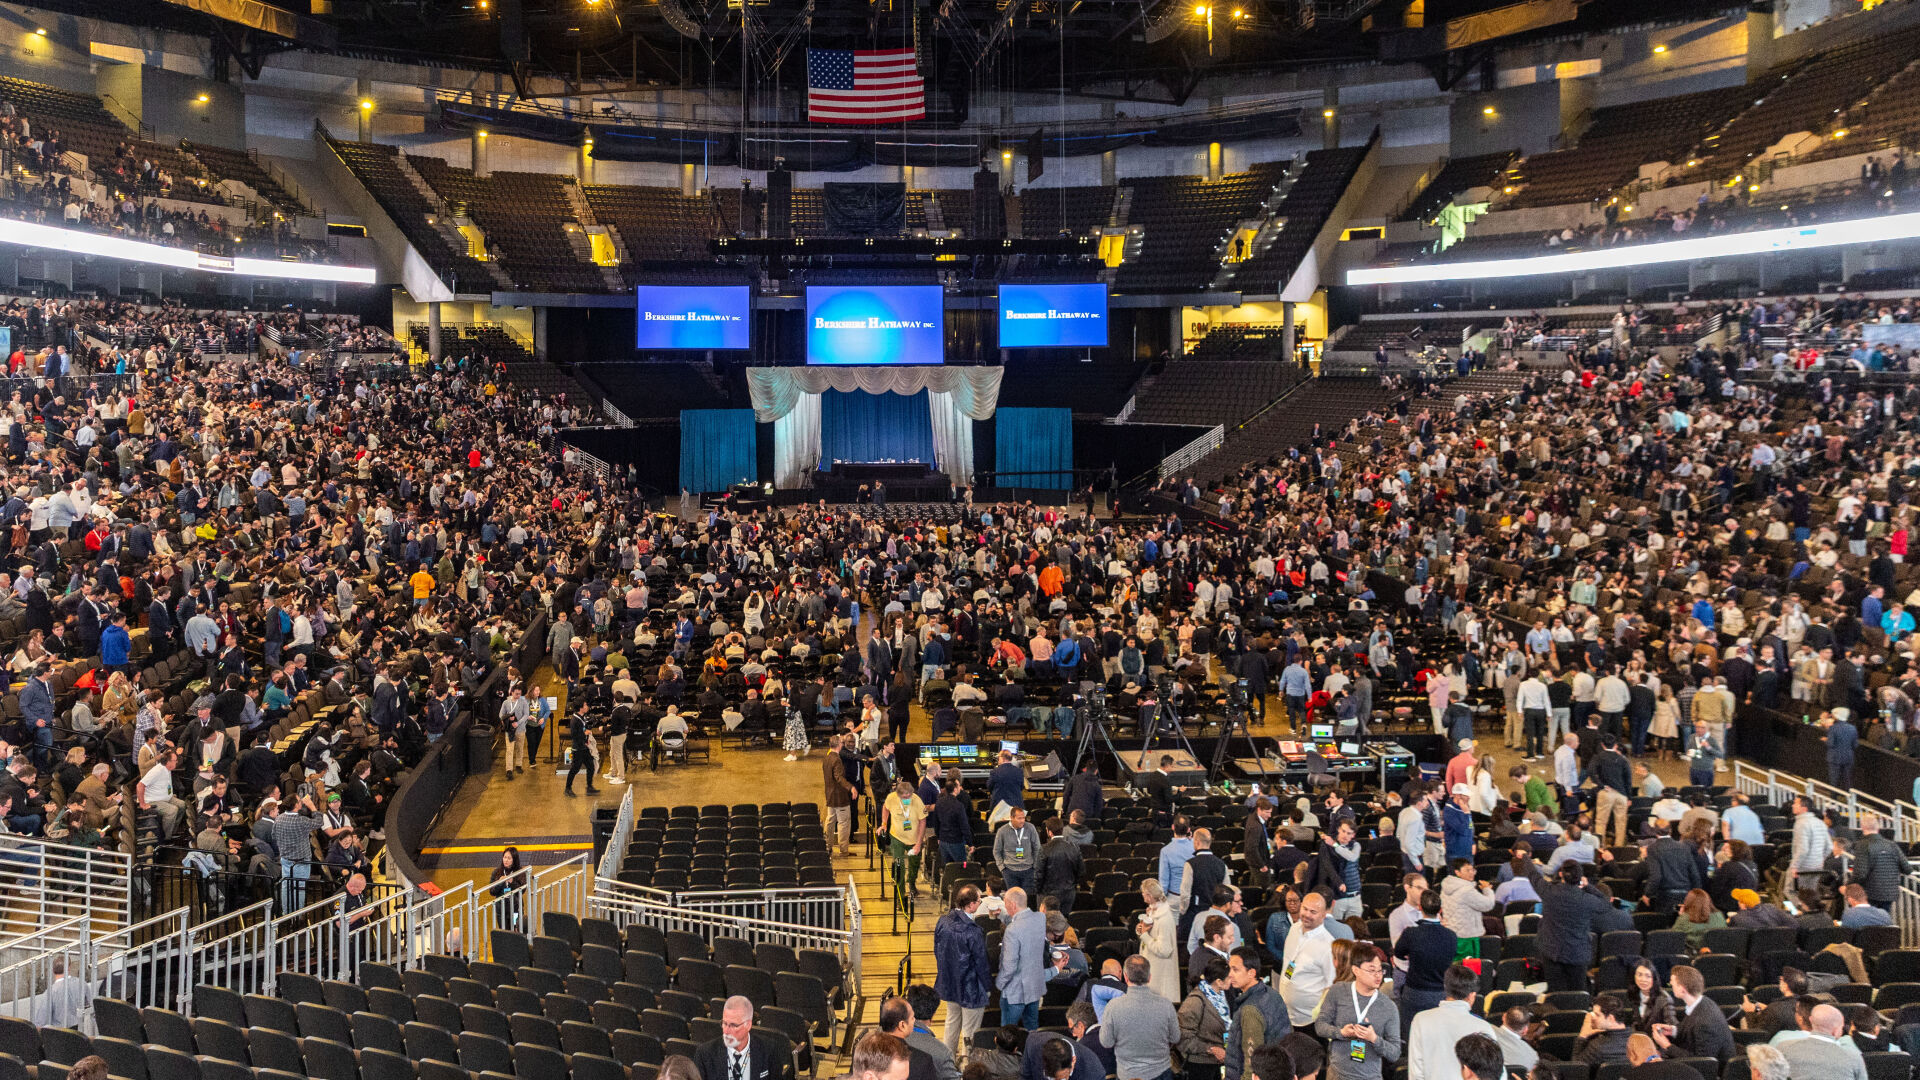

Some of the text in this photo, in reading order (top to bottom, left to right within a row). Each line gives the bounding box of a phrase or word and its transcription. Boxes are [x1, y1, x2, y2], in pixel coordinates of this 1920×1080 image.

[644, 311, 686, 321] BERKSHIRE
[687, 311, 731, 321] HATHAWAY
[1006, 310, 1047, 319] BERKSHIRE
[1048, 309, 1090, 319] HATHAWAY
[815, 317, 866, 329] BERKSHIRE
[868, 317, 921, 329] HATHAWAY
